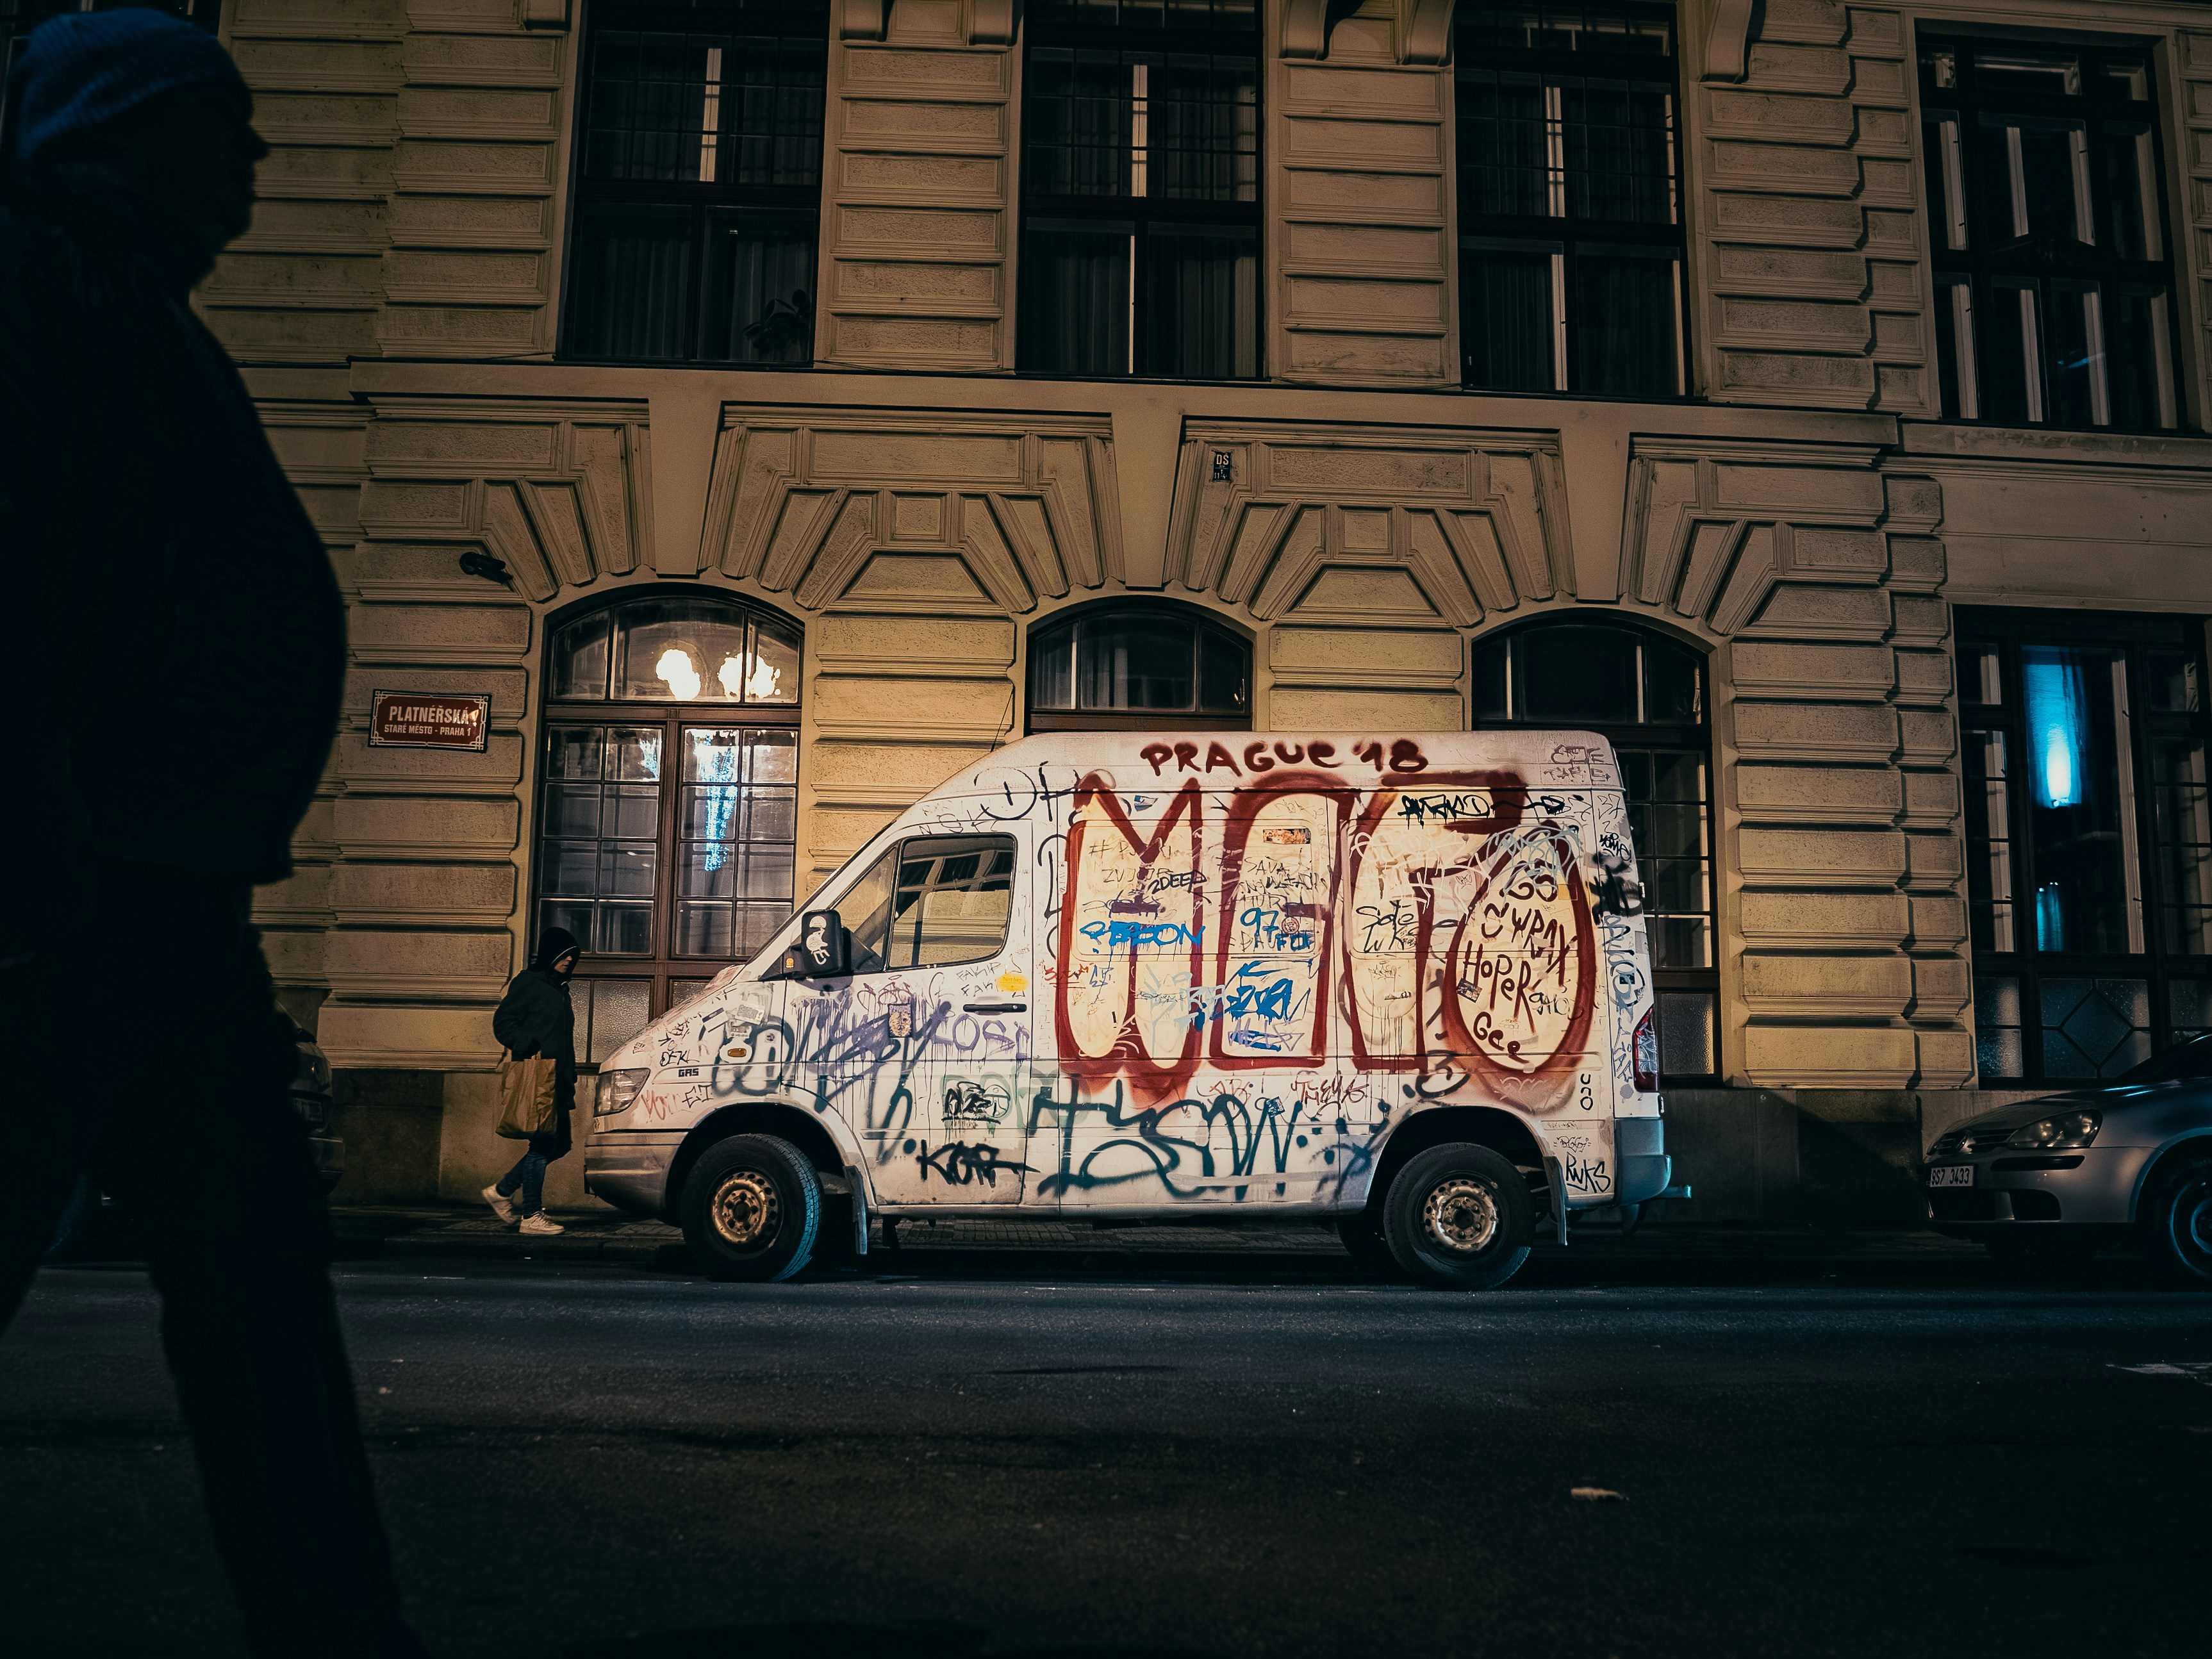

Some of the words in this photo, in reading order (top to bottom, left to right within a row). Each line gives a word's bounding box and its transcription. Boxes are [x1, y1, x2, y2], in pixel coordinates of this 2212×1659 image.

[388, 705, 469, 725] PLATNÉŘSKÁ
[384, 723, 406, 734] STARÉ
[409, 724, 433, 734] MĚSTO
[440, 726, 465, 736] PRAHA
[466, 728, 471, 736] 1
[678, 1068, 699, 1078] GAS
[1931, 1169, 1945, 1185] 9S7
[1949, 1168, 1970, 1185] 3433
